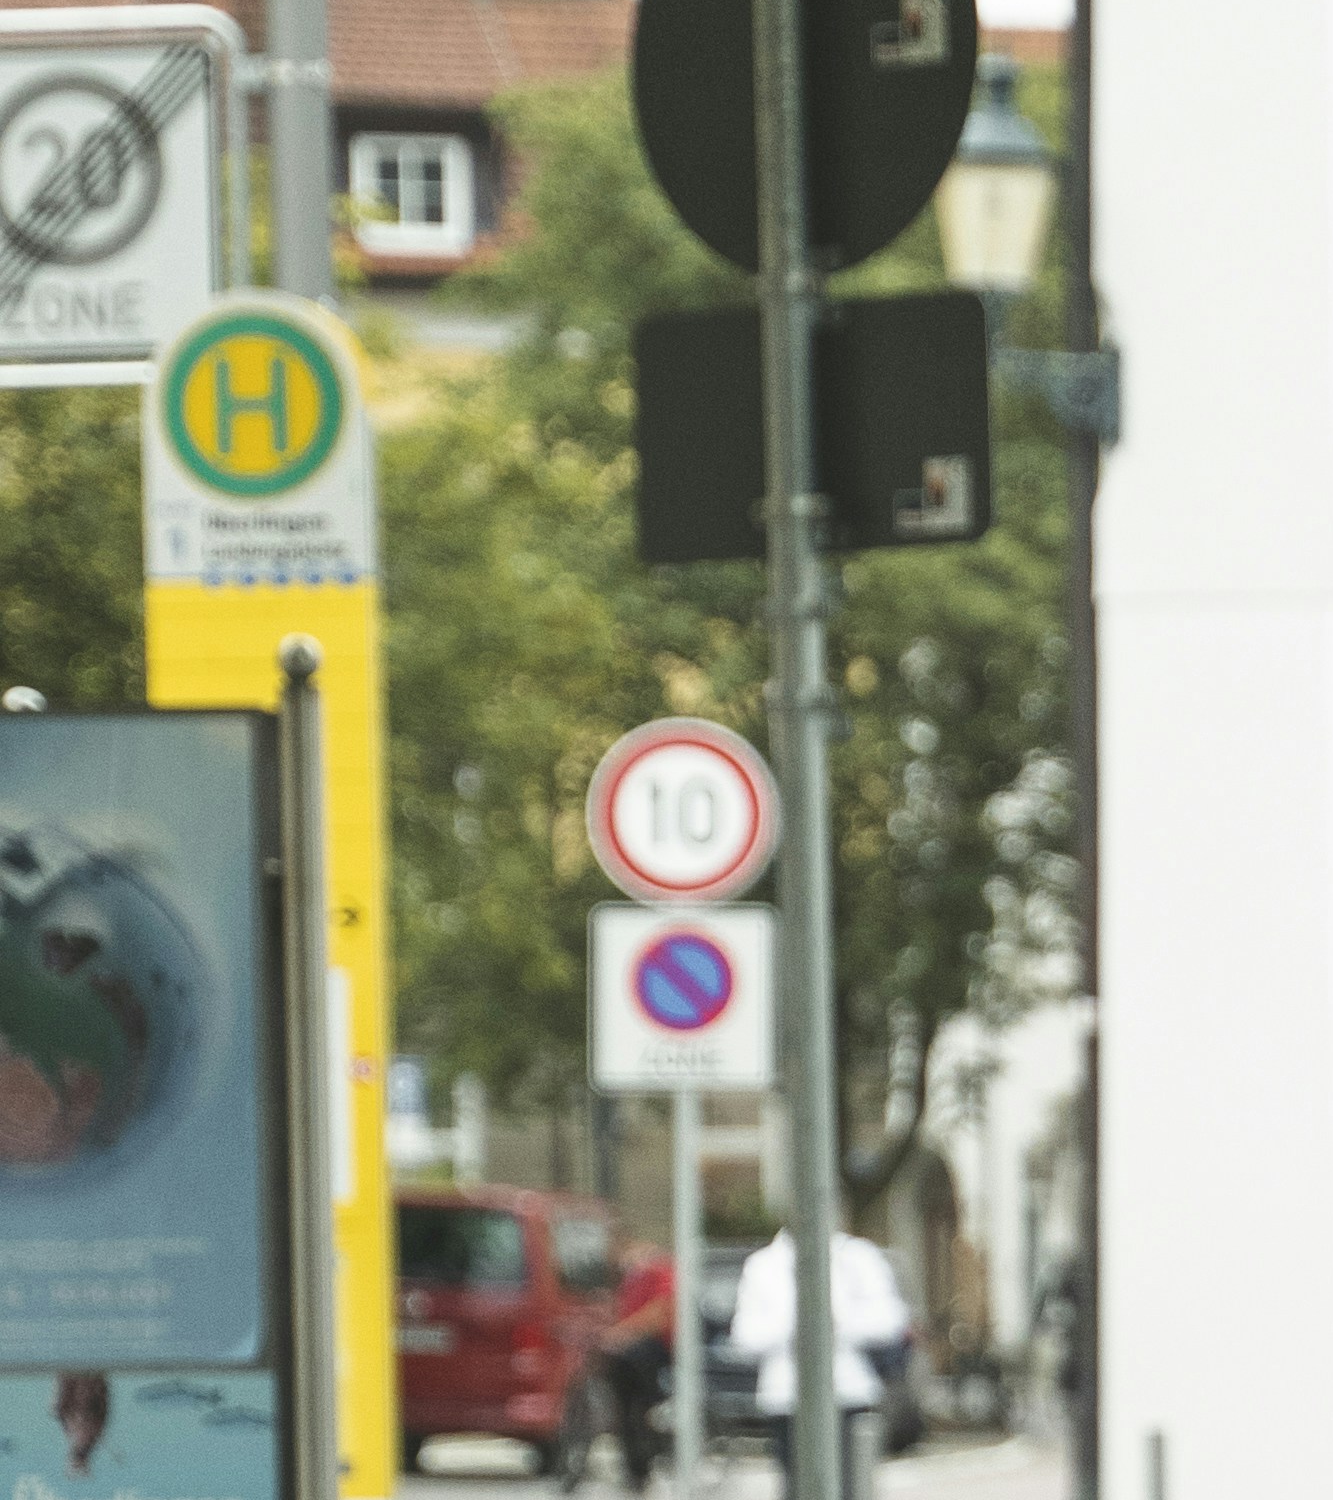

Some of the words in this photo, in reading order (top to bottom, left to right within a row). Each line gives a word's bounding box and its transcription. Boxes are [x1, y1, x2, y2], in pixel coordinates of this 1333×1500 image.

[22, 126, 122, 211] 20
[213, 356, 287, 455] H
[647, 776, 716, 844] 10
